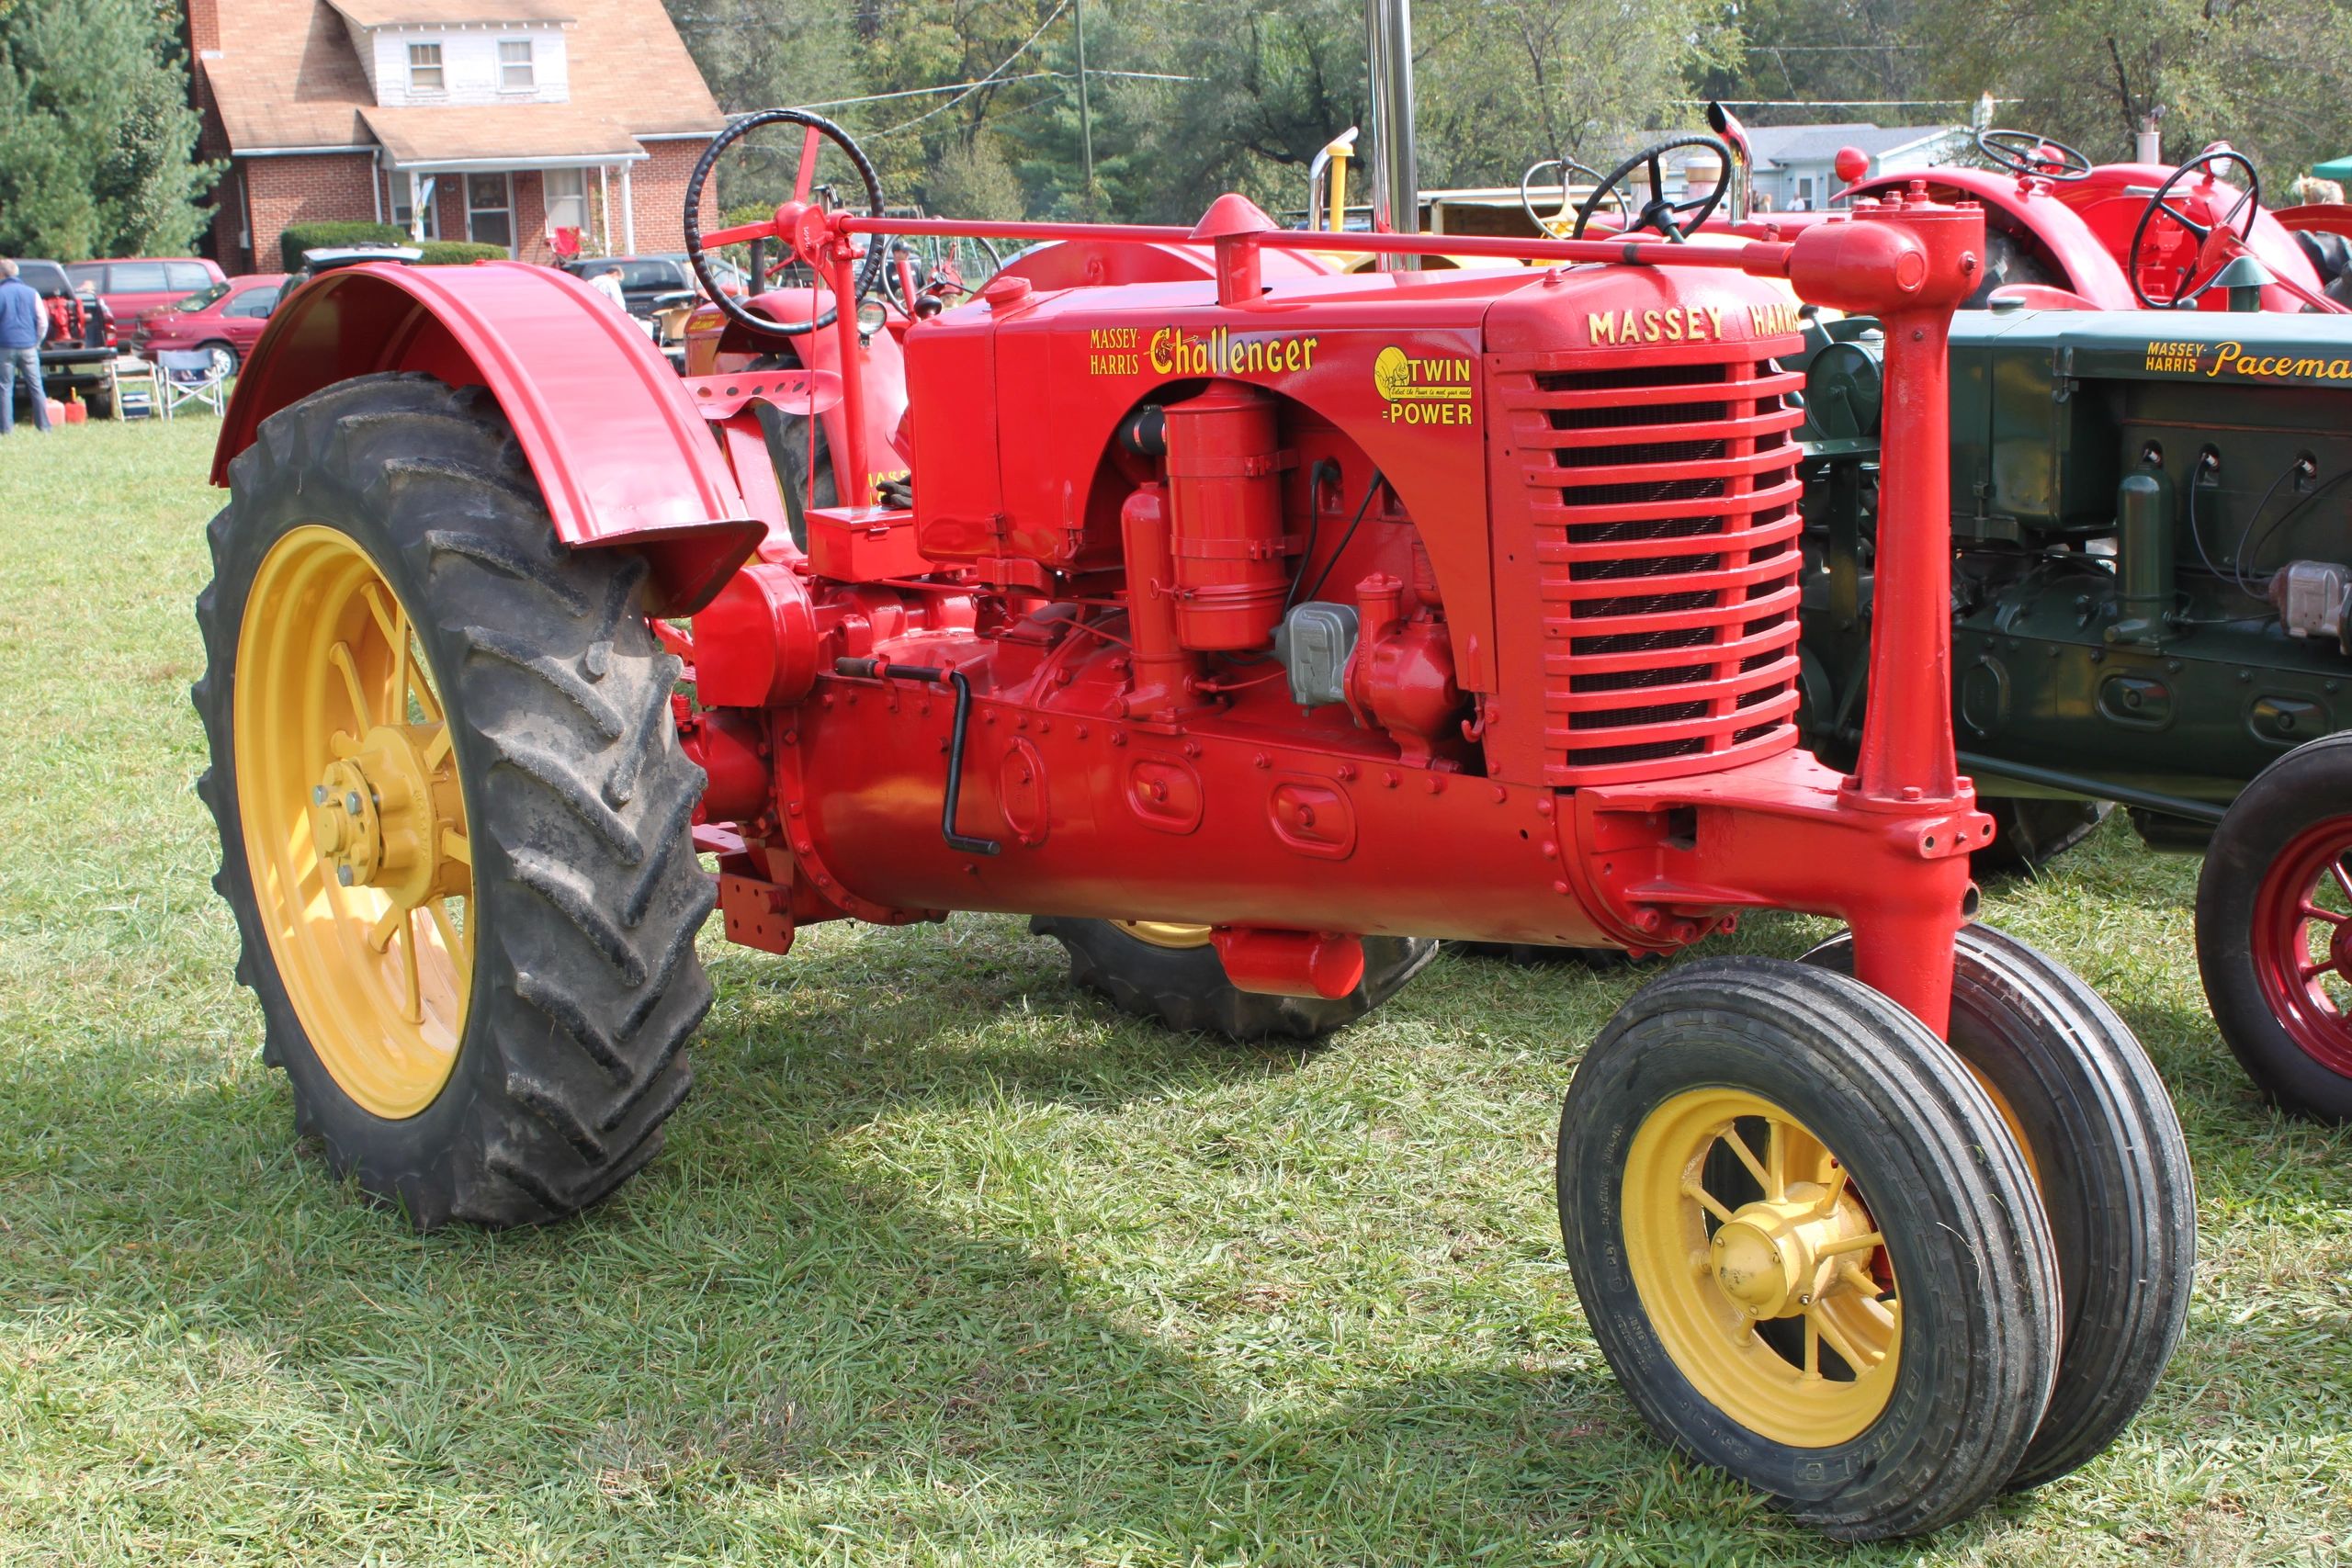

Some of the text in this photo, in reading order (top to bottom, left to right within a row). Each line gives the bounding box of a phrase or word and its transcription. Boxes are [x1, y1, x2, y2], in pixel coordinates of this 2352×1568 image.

[1588, 307, 1723, 345] MASSEY
[1150, 324, 1318, 375] Challenger
[2206, 341, 2352, 379] Pacema
[1091, 355, 1139, 375] HARRIS
[1408, 359, 1470, 381] TWIN
[2145, 356, 2197, 373] HARRIS
[1390, 402, 1473, 424] POWER
